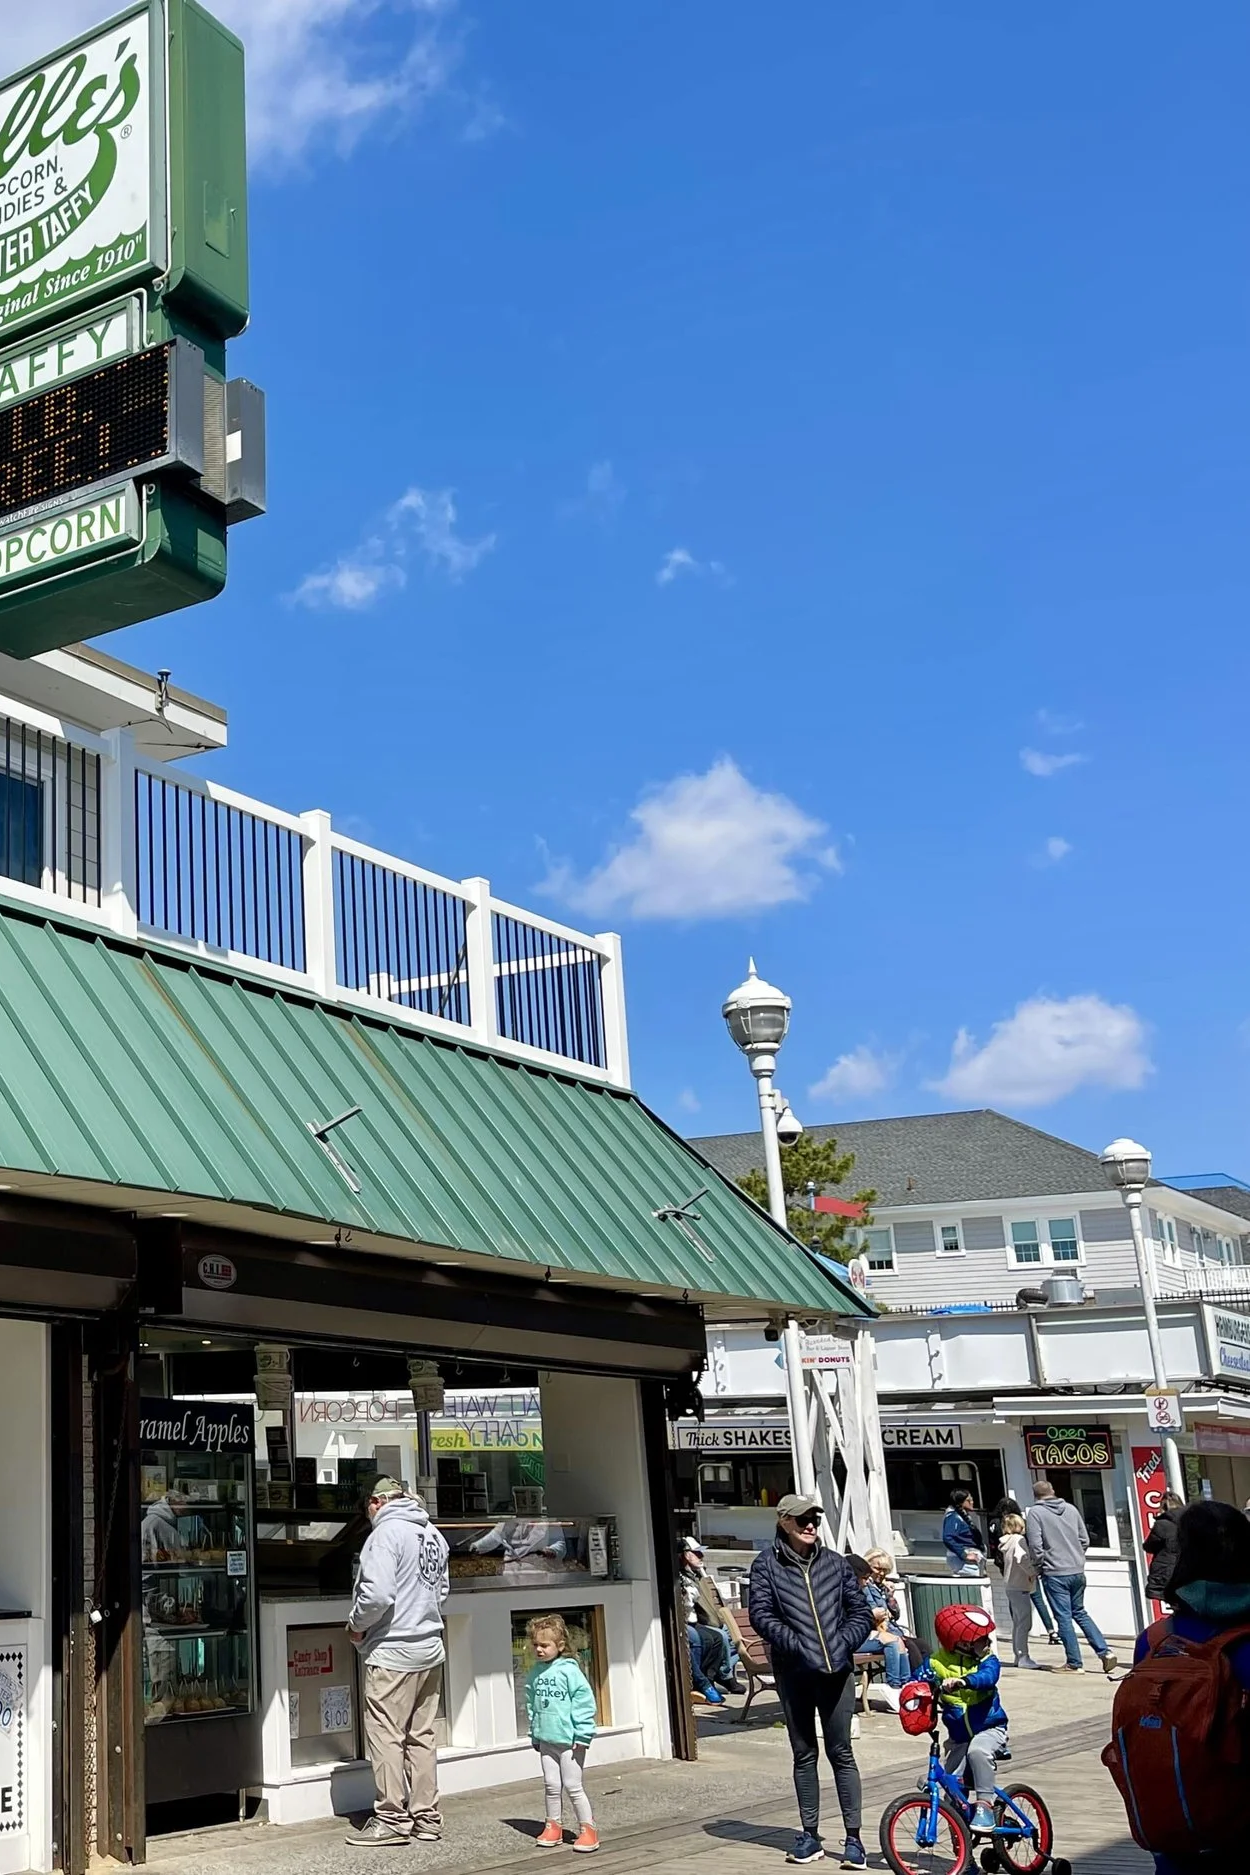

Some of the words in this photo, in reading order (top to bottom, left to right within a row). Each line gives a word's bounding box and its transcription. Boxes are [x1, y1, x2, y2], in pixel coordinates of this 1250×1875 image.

[53, 180, 69, 197] &
[37, 182, 95, 250] TAFFY
[43, 263, 90, 299] Since
[189, 1413, 250, 1452] Apples
[430, 1432, 465, 1448] resh
[685, 1430, 721, 1448] Thick
[723, 1430, 794, 1446] SHAKES
[882, 1429, 955, 1446] CREAM
[1046, 1426, 1087, 1440] Open
[1030, 1442, 1109, 1465] TACOS
[1136, 1450, 1162, 1485] Fried
[537, 1676, 557, 1687] bad
[535, 1687, 568, 1701] onkey
